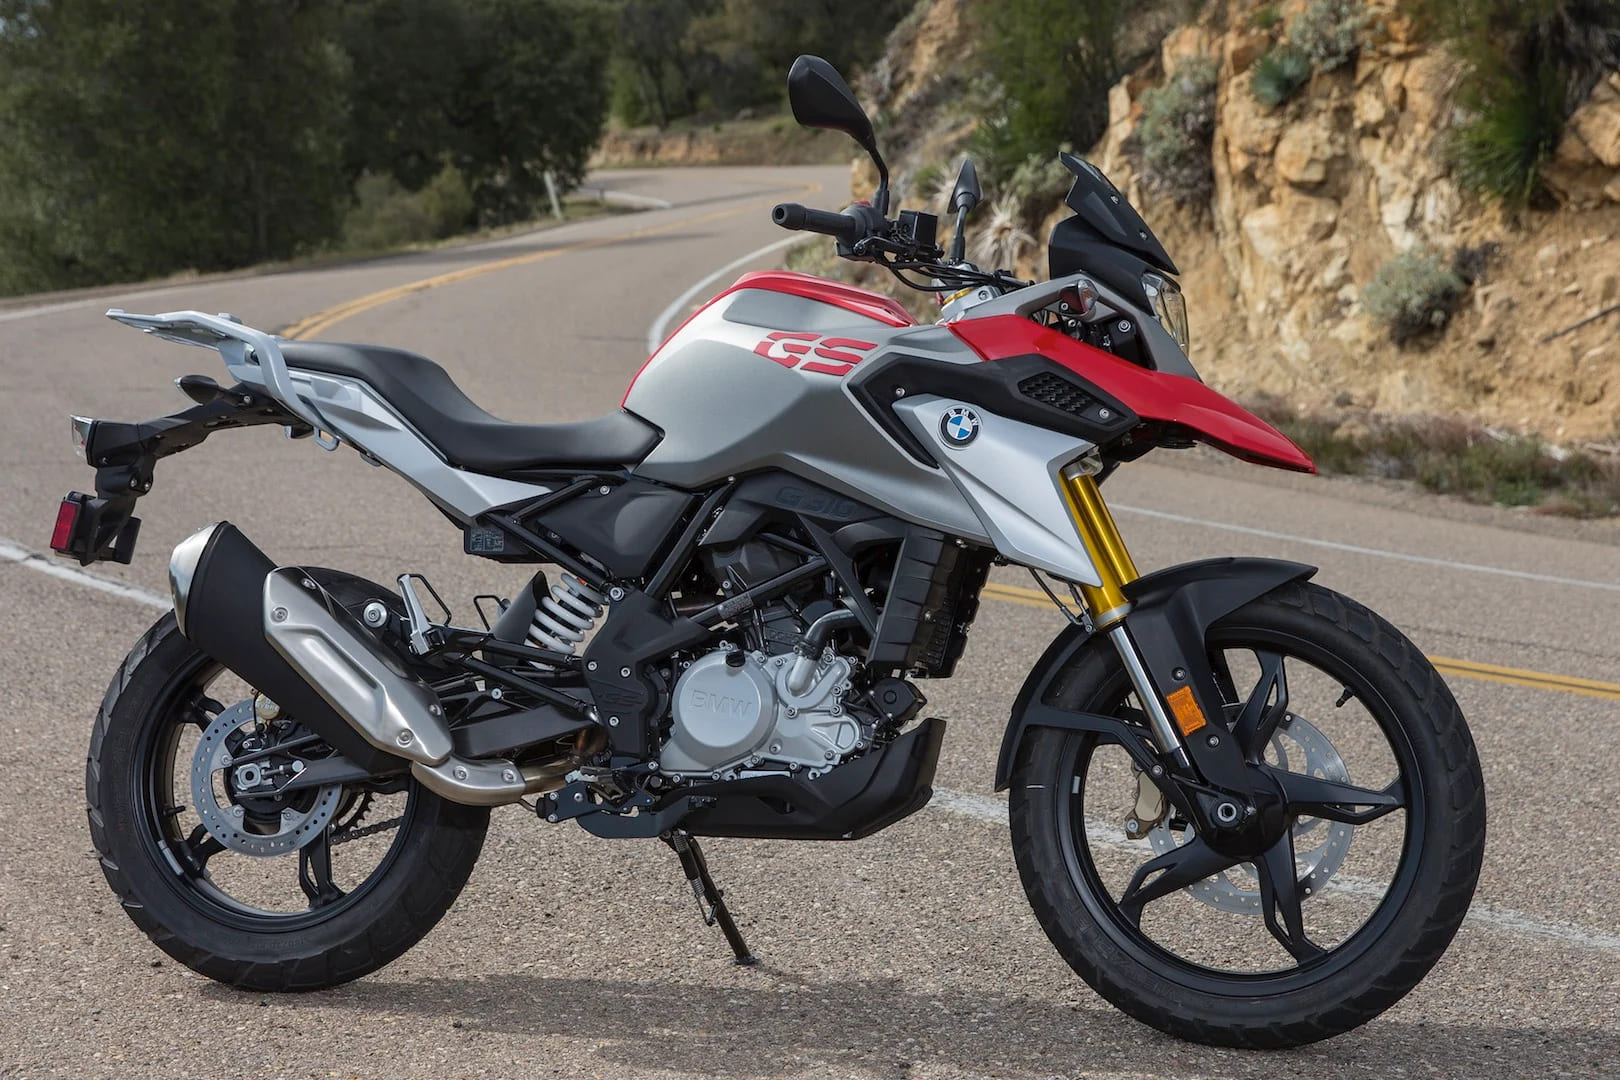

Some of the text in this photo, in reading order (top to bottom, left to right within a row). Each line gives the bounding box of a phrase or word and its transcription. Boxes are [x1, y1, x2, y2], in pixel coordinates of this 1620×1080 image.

[753, 331, 879, 376] GS
[949, 408, 980, 426] BMW
[689, 689, 753, 720] BMW
